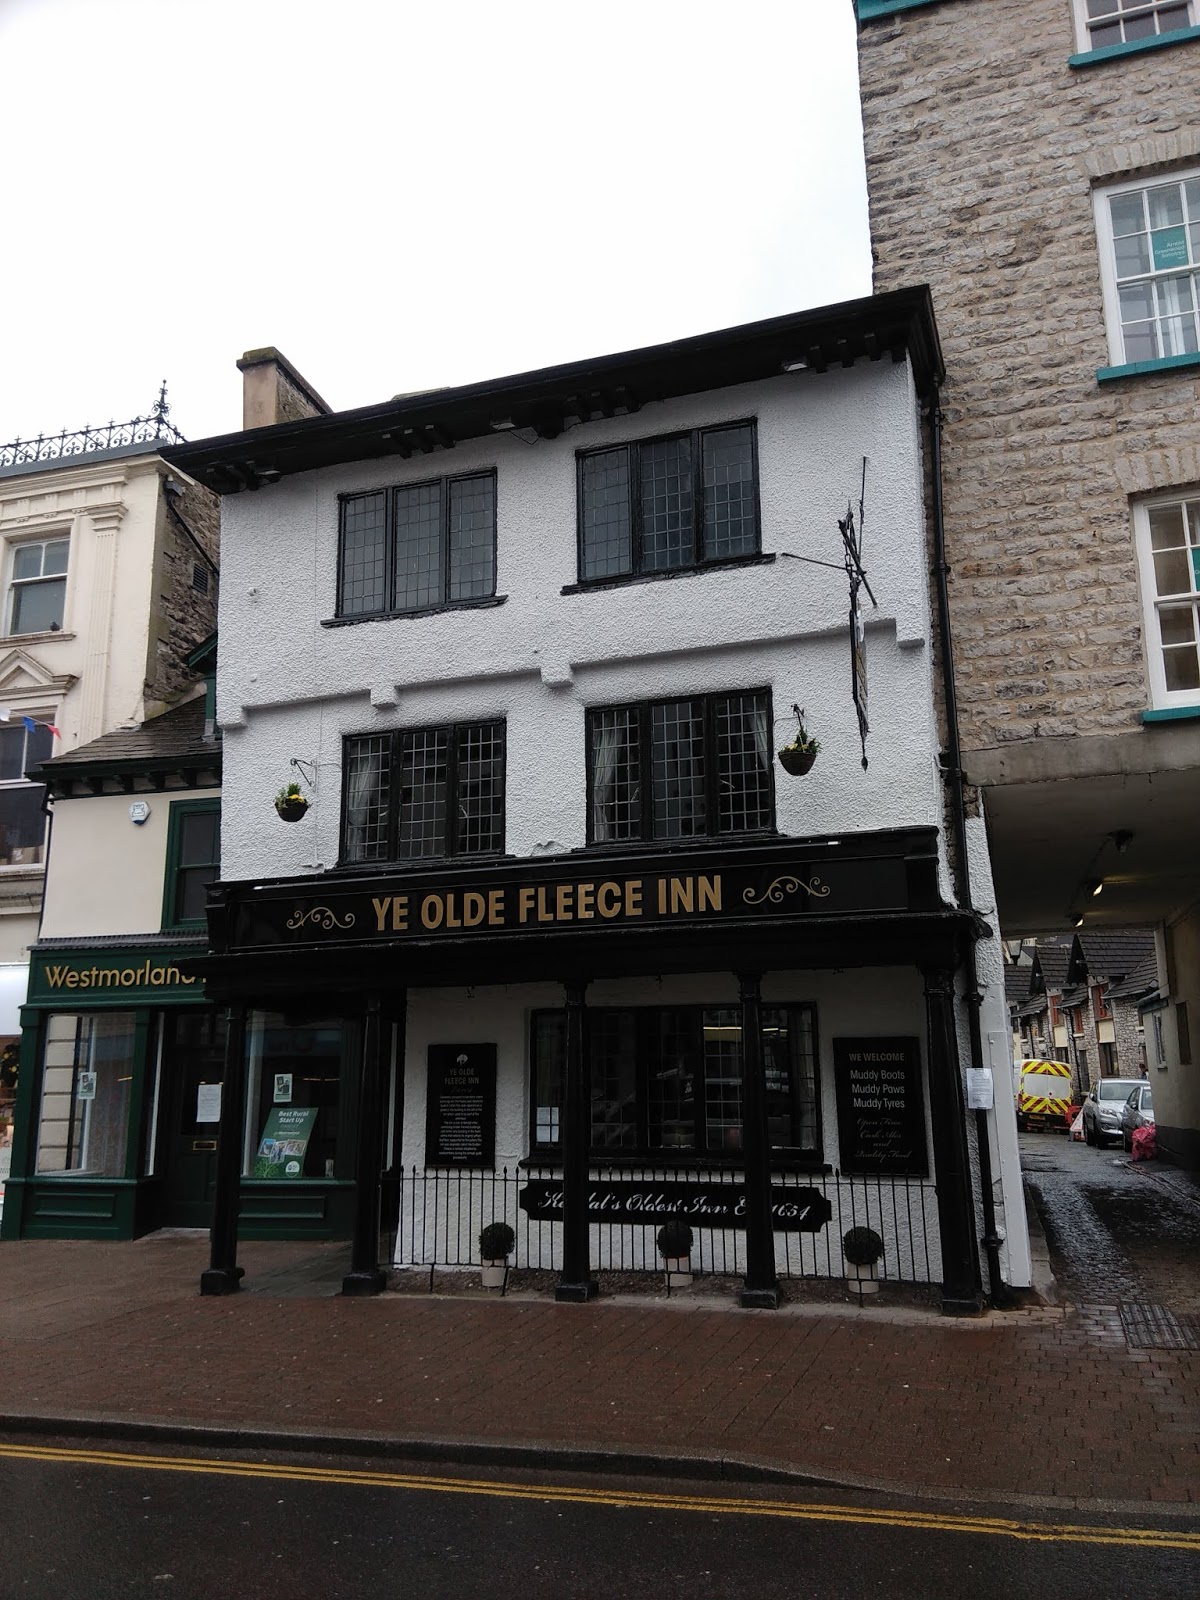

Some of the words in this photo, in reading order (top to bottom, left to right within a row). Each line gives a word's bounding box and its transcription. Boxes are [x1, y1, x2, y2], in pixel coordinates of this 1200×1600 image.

[372, 896, 409, 932] YE
[421, 889, 505, 930] OLDE
[519, 880, 643, 923] FLEECE
[658, 874, 722, 915] INN
[849, 1053, 862, 1062] WE
[863, 1053, 905, 1062] WELCOME
[850, 1069, 879, 1081] Muddy
[881, 1069, 906, 1080] Boots
[851, 1084, 881, 1096] Muddy
[882, 1084, 905, 1094] Paws
[853, 1097, 882, 1110] Muddy
[882, 1097, 906, 1110] Tyres
[624, 1192, 683, 1213] Oldest
[683, 1195, 729, 1214] Inn
